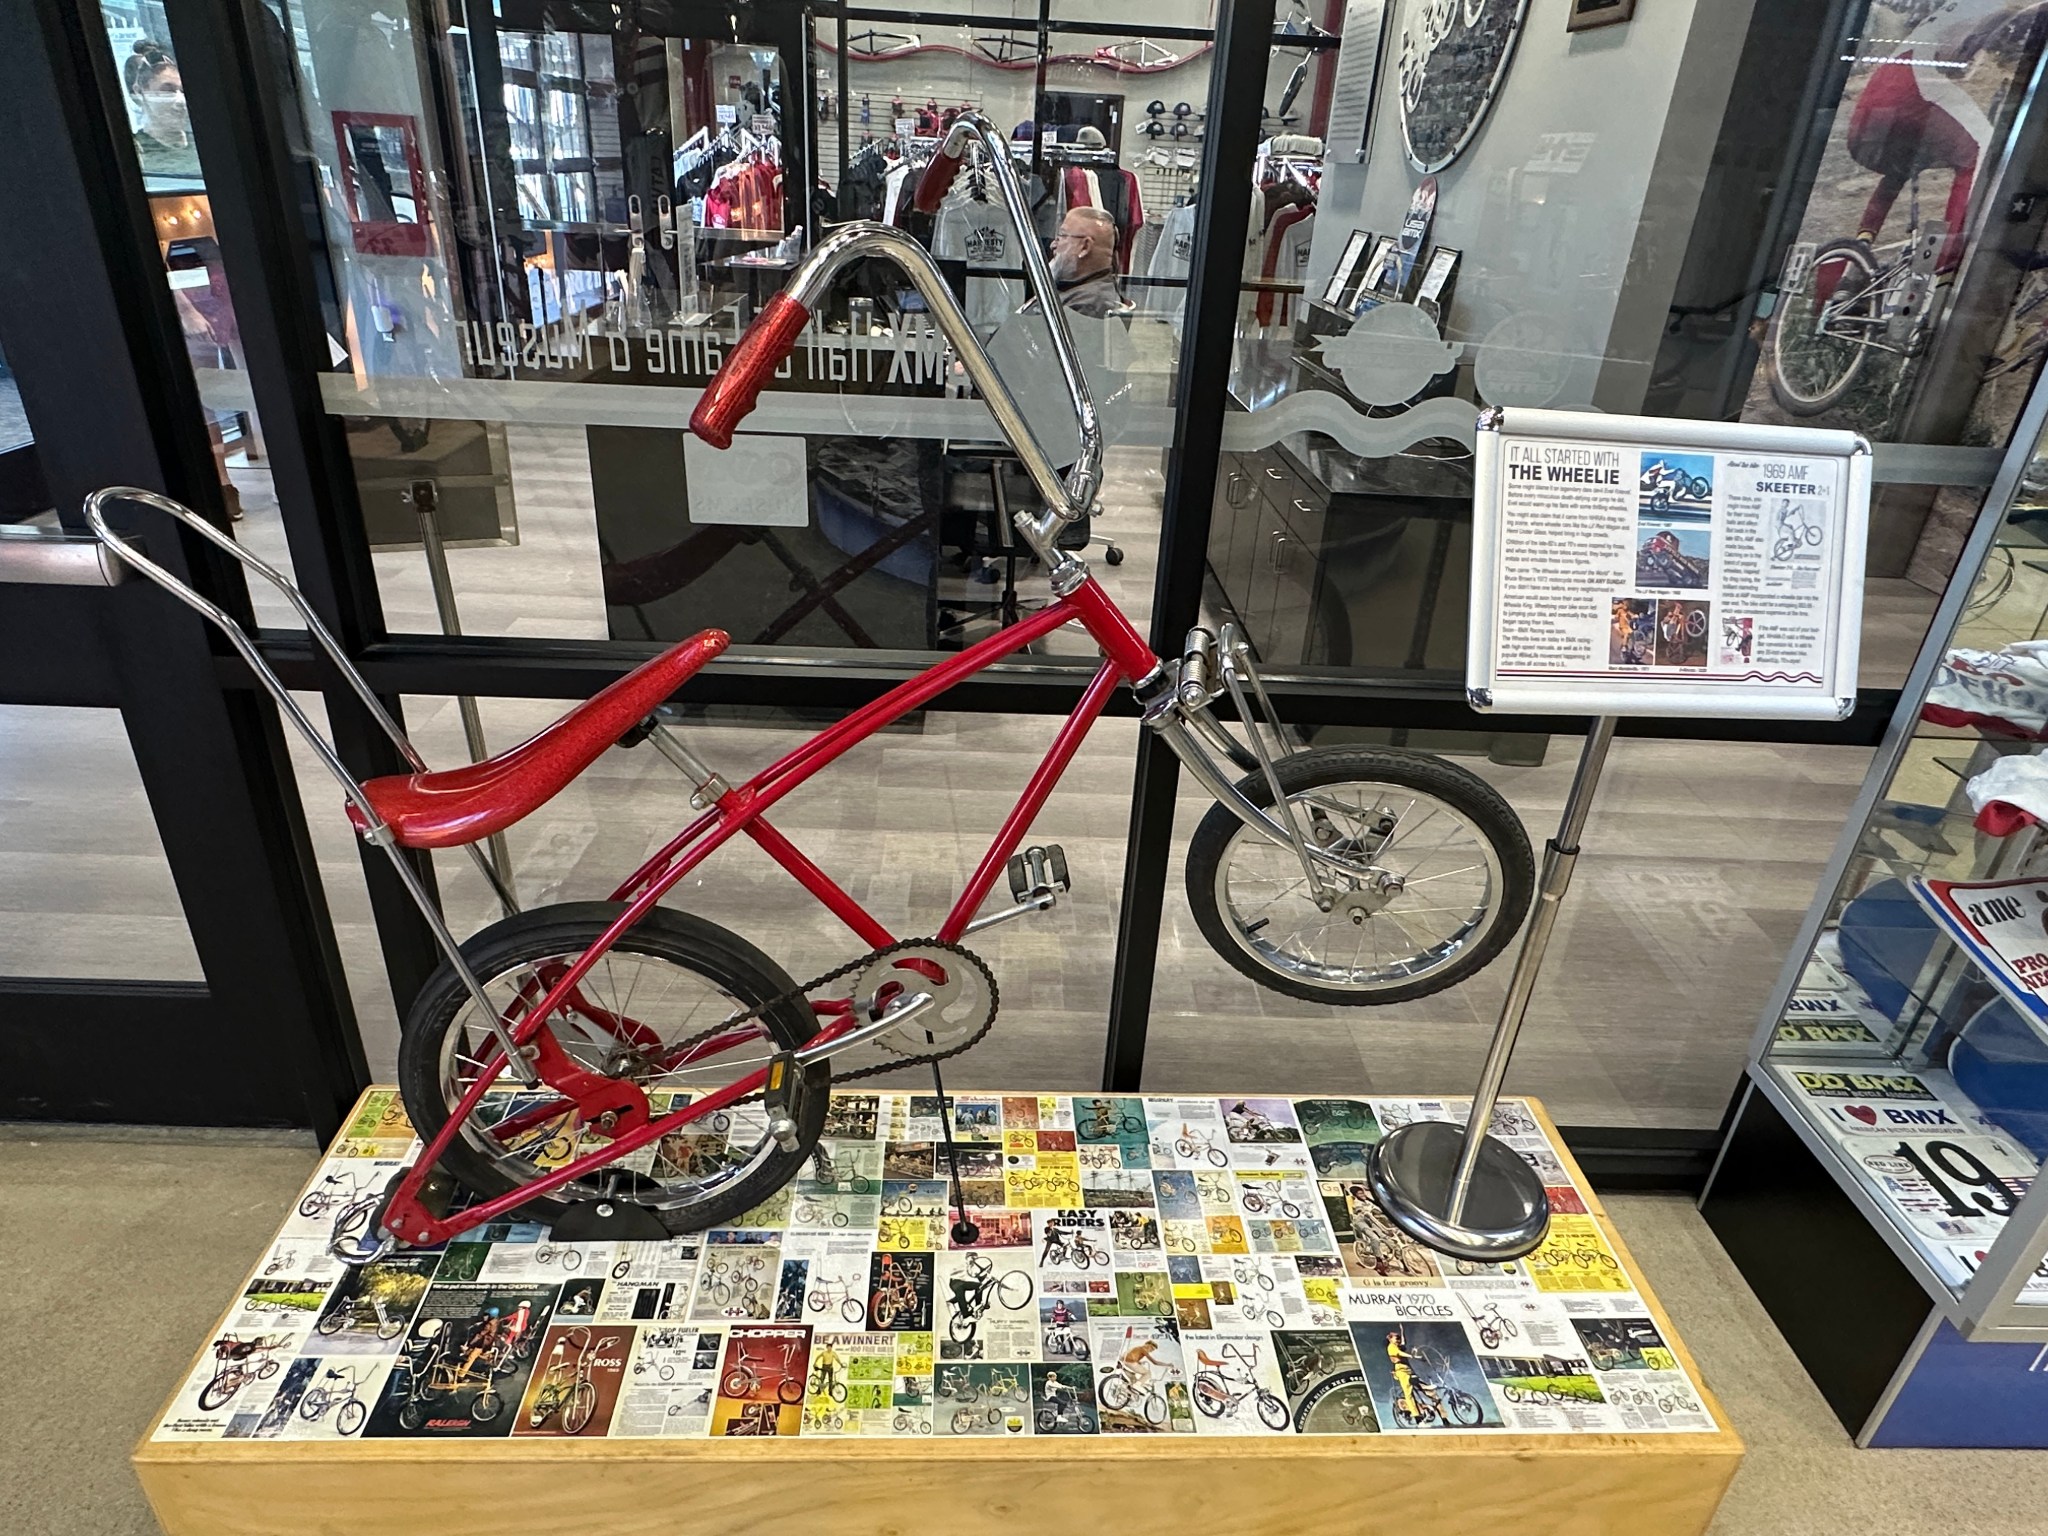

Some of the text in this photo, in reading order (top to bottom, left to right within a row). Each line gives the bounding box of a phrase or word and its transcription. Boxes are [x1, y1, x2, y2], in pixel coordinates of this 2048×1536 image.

[1511, 447, 1619, 467] IT ALL STARTED WITH
[1509, 465, 1619, 484] THE WHEELIE
[1763, 464, 1809, 480] 1969 AMF
[1756, 482, 1815, 494] SKEETER
[1796, 1073, 1924, 1092] DO BMX
[1883, 1109, 1957, 1124] BMX
[1893, 1141, 2022, 1217] 19
[1058, 1210, 1098, 1218] EASY
[1053, 1218, 1104, 1227] RIDERS
[1348, 1294, 1436, 1305] MURRAY 1970
[1395, 1306, 1454, 1316] BICYCLES
[729, 1329, 806, 1338] CHOPPER
[814, 1335, 830, 1344] BE
[831, 1335, 840, 1344] A
[593, 1358, 622, 1367] ROSS
[426, 1420, 472, 1428] RALEIGH
